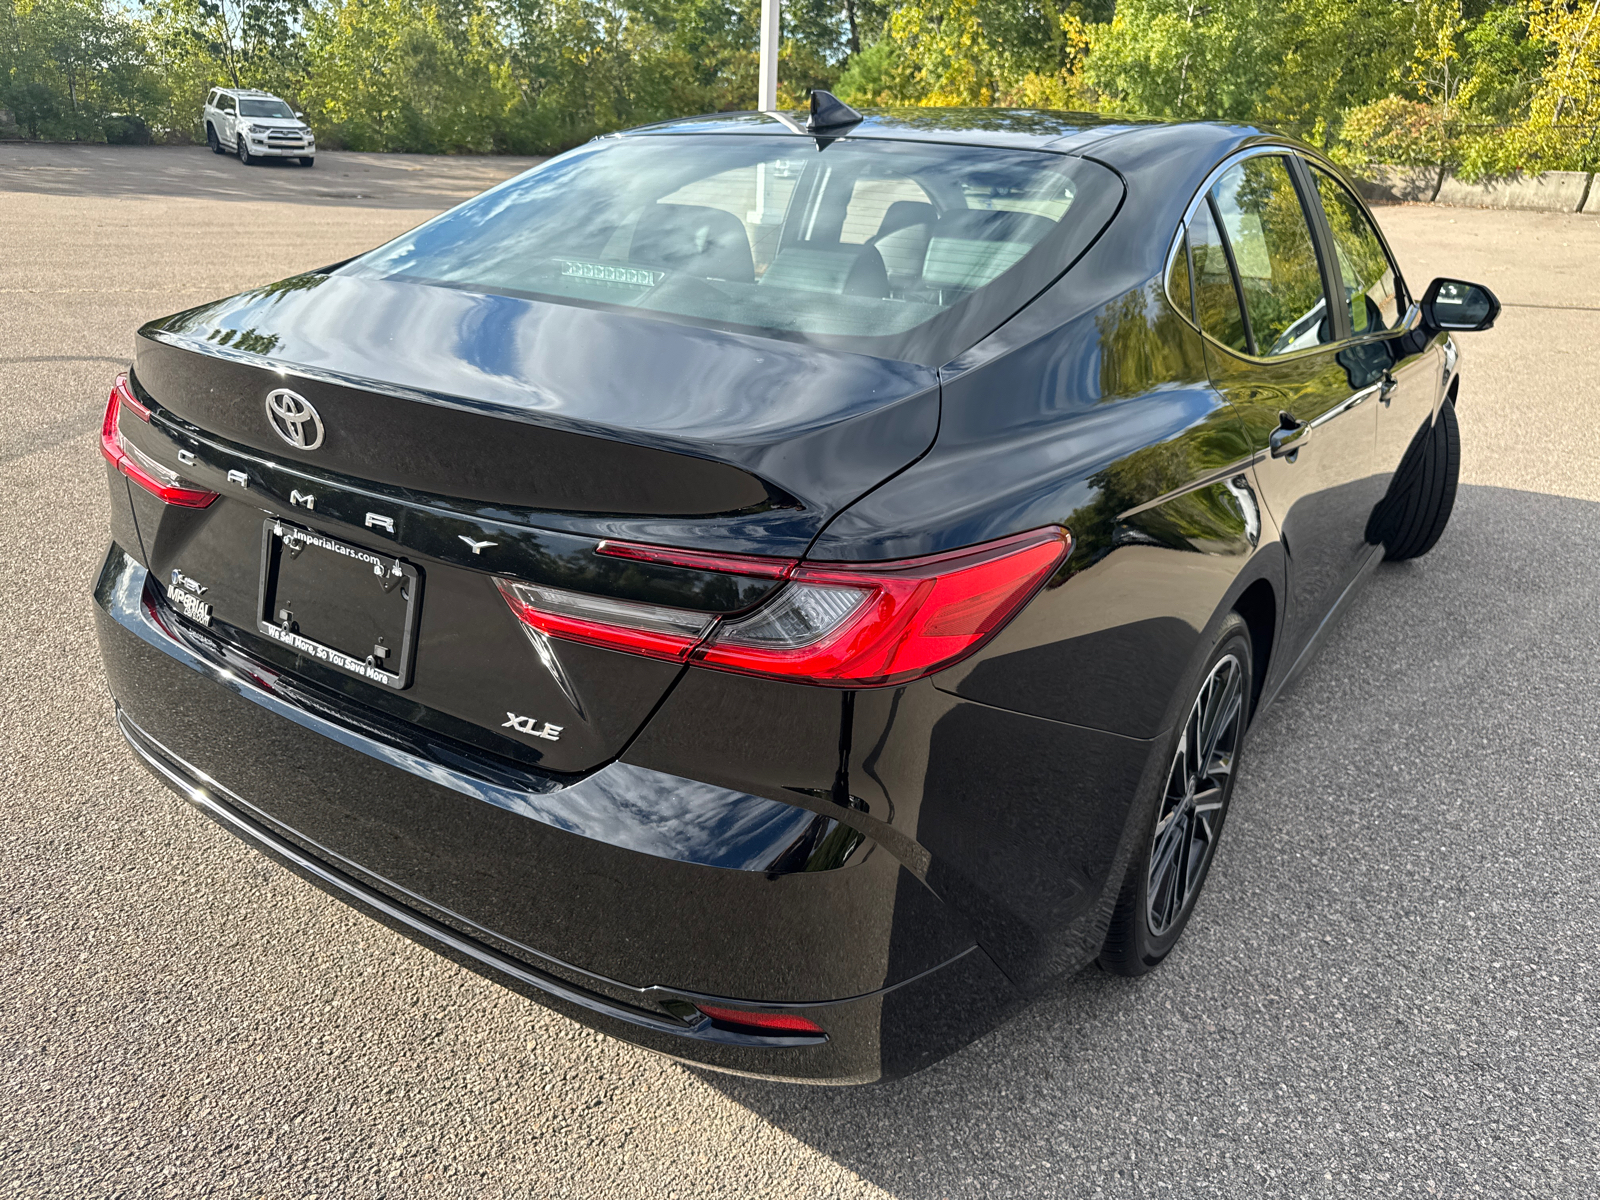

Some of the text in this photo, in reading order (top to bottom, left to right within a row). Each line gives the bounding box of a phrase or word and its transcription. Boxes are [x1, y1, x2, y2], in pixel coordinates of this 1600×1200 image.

[177, 448, 499, 554] CAMRY
[293, 528, 381, 567] Imperialcars.com
[267, 626, 388, 684] We Sell More, So You Save More
[501, 711, 564, 741] XLE
